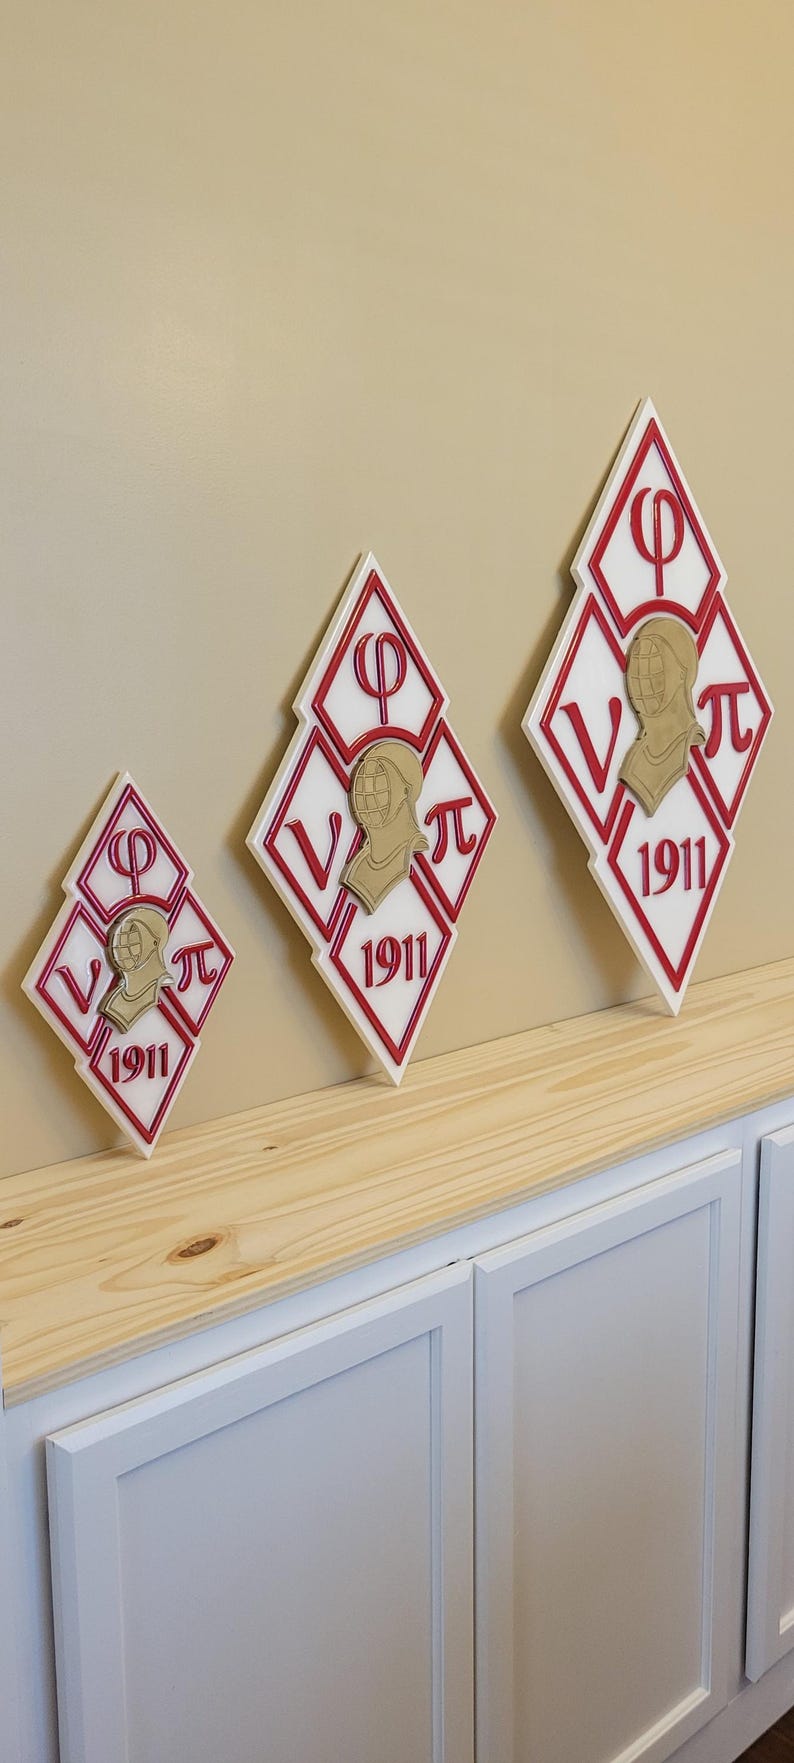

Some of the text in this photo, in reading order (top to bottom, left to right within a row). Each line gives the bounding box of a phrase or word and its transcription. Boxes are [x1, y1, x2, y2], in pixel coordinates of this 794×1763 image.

[697, 681, 754, 759] π
[424, 796, 477, 864] π
[637, 836, 706, 897] 1911
[171, 941, 218, 992] π
[360, 931, 427, 988] 1911
[108, 1043, 169, 1083] 1911
